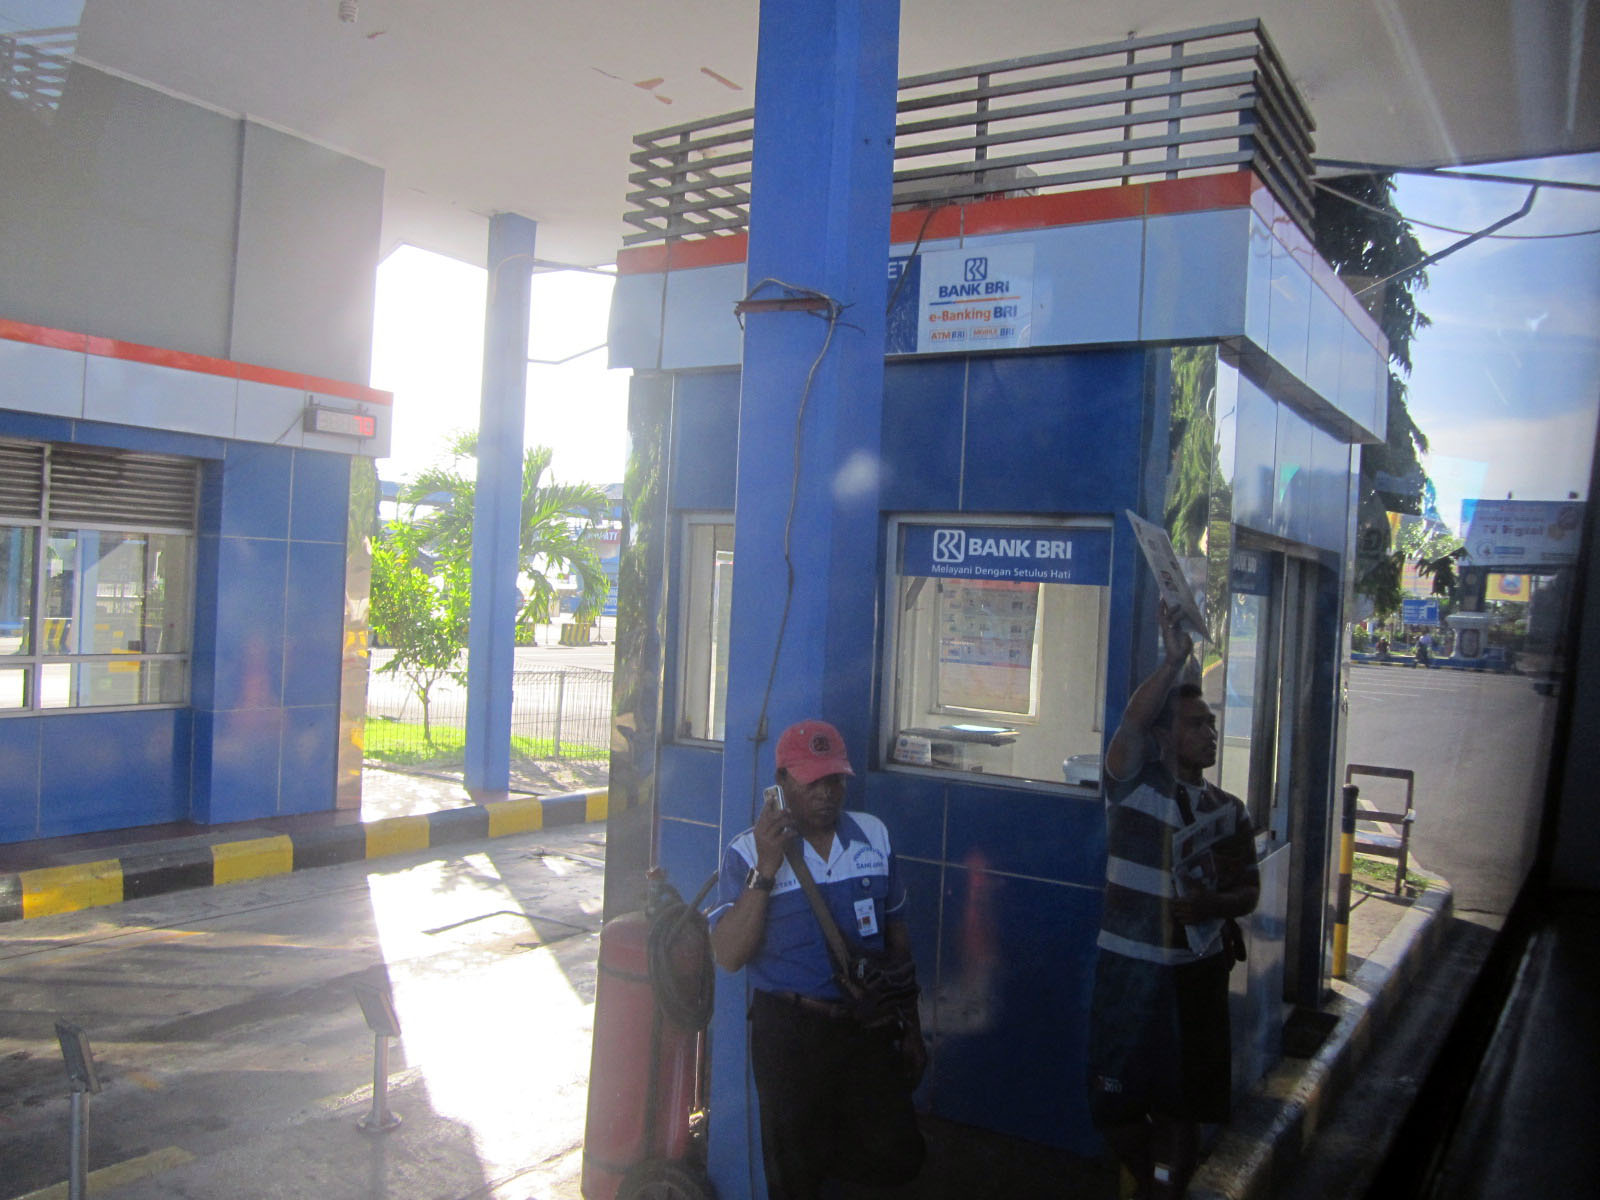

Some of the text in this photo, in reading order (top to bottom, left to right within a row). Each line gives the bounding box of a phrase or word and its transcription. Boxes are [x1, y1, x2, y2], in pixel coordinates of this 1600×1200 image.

[938, 281, 1010, 298] BANK BRI
[929, 305, 1018, 322] e-Banking BRI
[968, 538, 1073, 559] BANK BRI
[931, 564, 1072, 579] Melayani Dengan Setulus Hati
